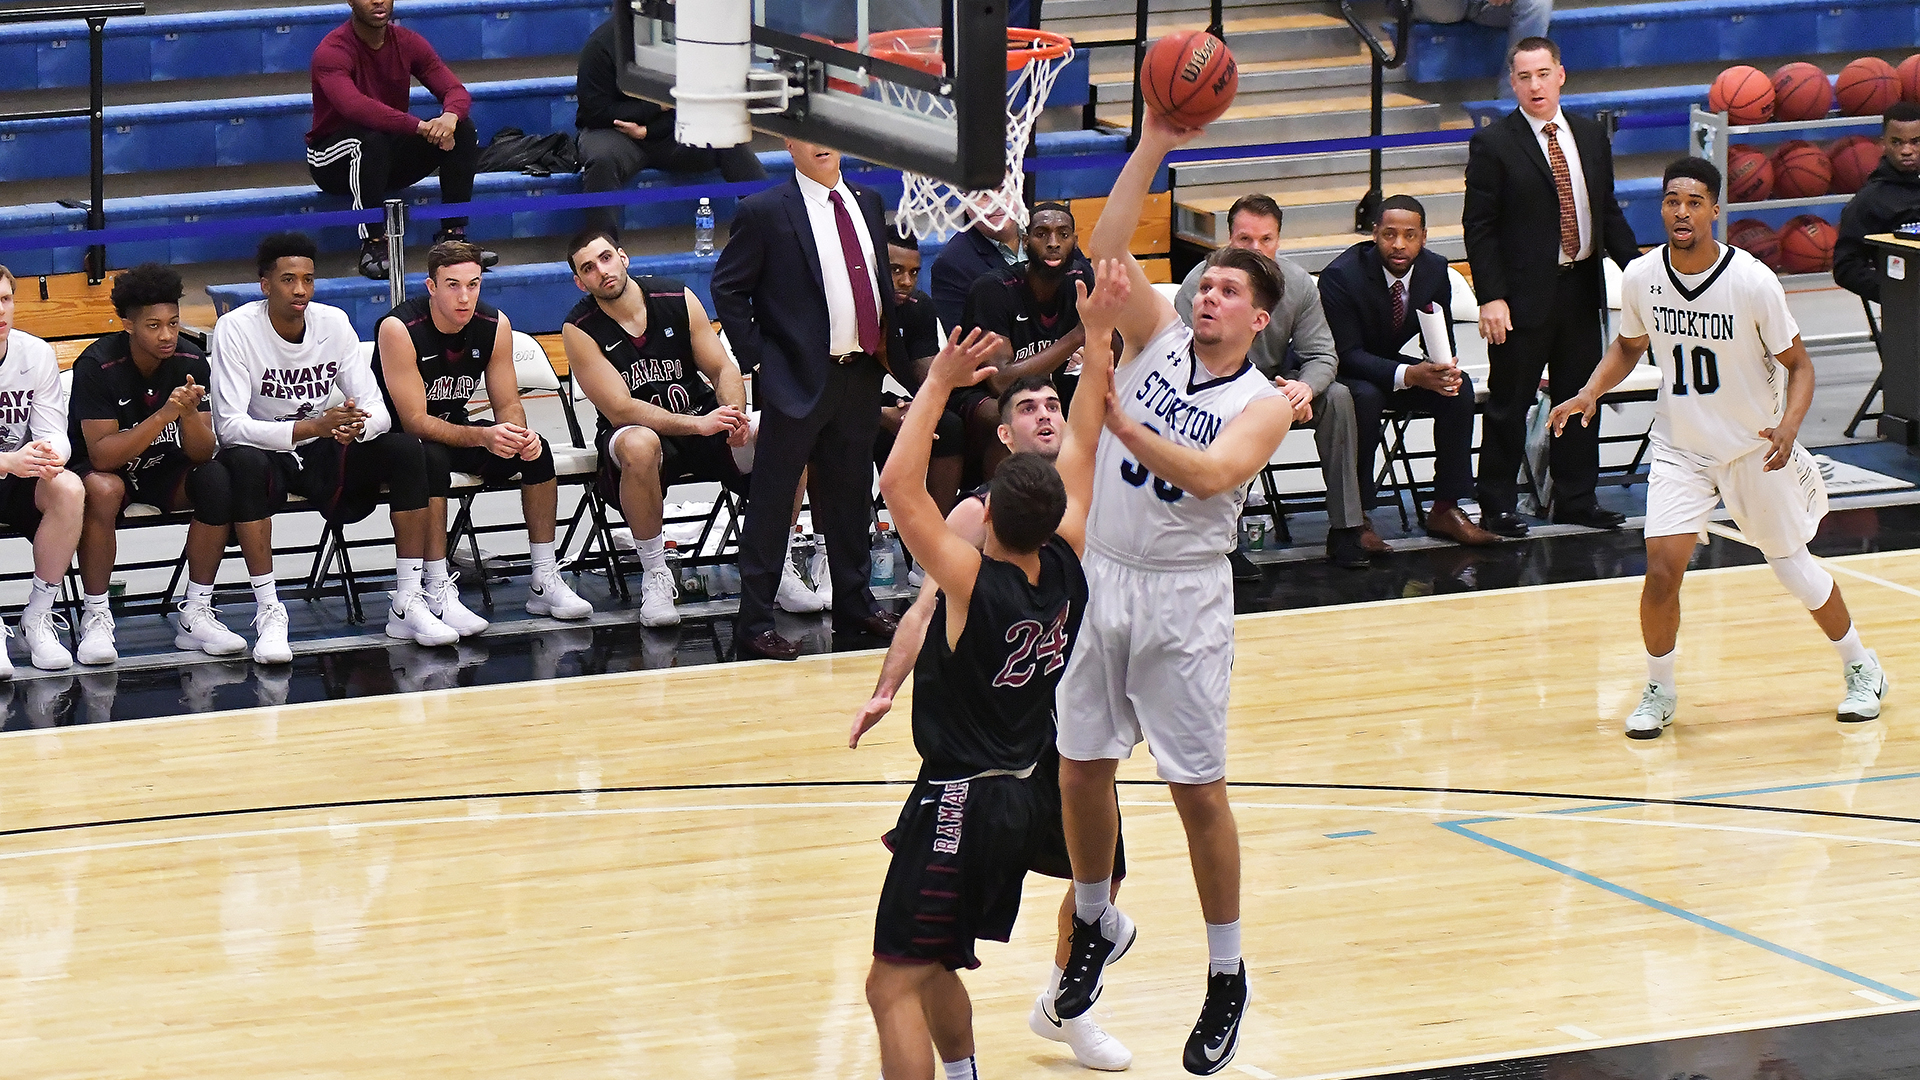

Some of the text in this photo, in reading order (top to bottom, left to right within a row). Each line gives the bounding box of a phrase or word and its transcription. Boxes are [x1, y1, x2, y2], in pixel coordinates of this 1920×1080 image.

[1652, 306, 1734, 340] STOCKTON
[425, 375, 481, 400] AMAP
[1672, 343, 1720, 395] 10
[992, 600, 1070, 688] 24
